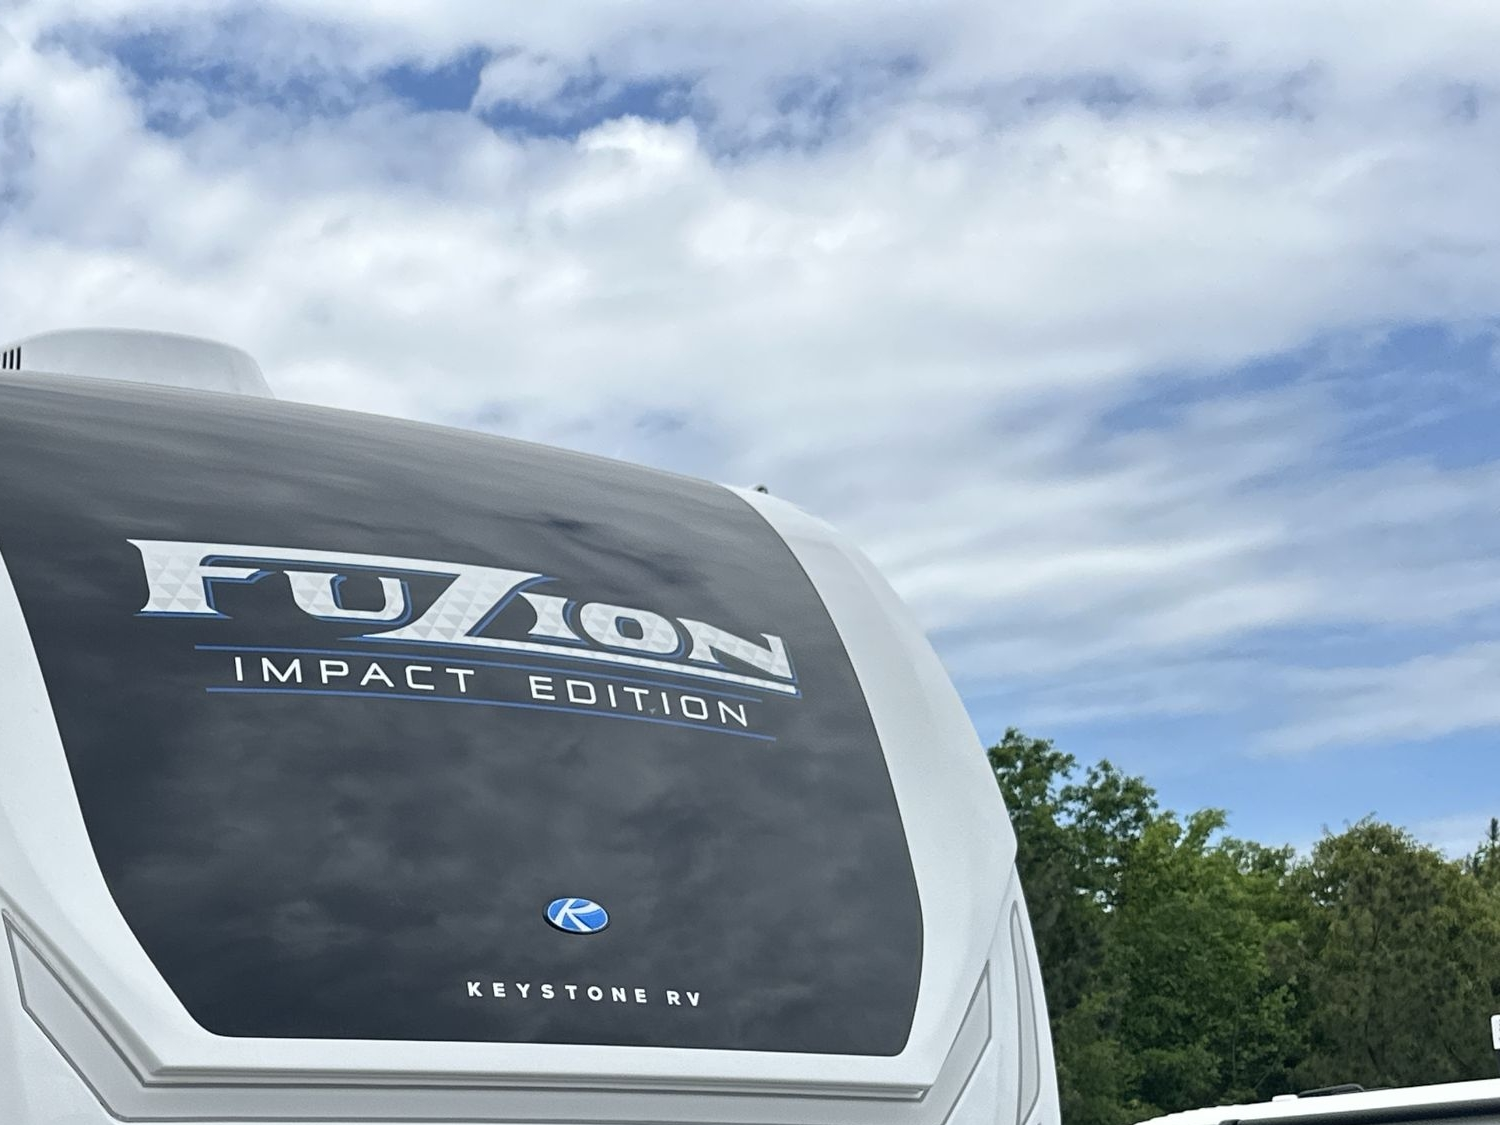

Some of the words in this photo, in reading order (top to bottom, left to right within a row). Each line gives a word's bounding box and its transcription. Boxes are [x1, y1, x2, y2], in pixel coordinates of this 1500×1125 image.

[234, 655, 475, 694] IMPACT
[528, 675, 749, 728] EDITION
[466, 981, 648, 1004] KEYSTONE
[666, 990, 700, 1007] RV
